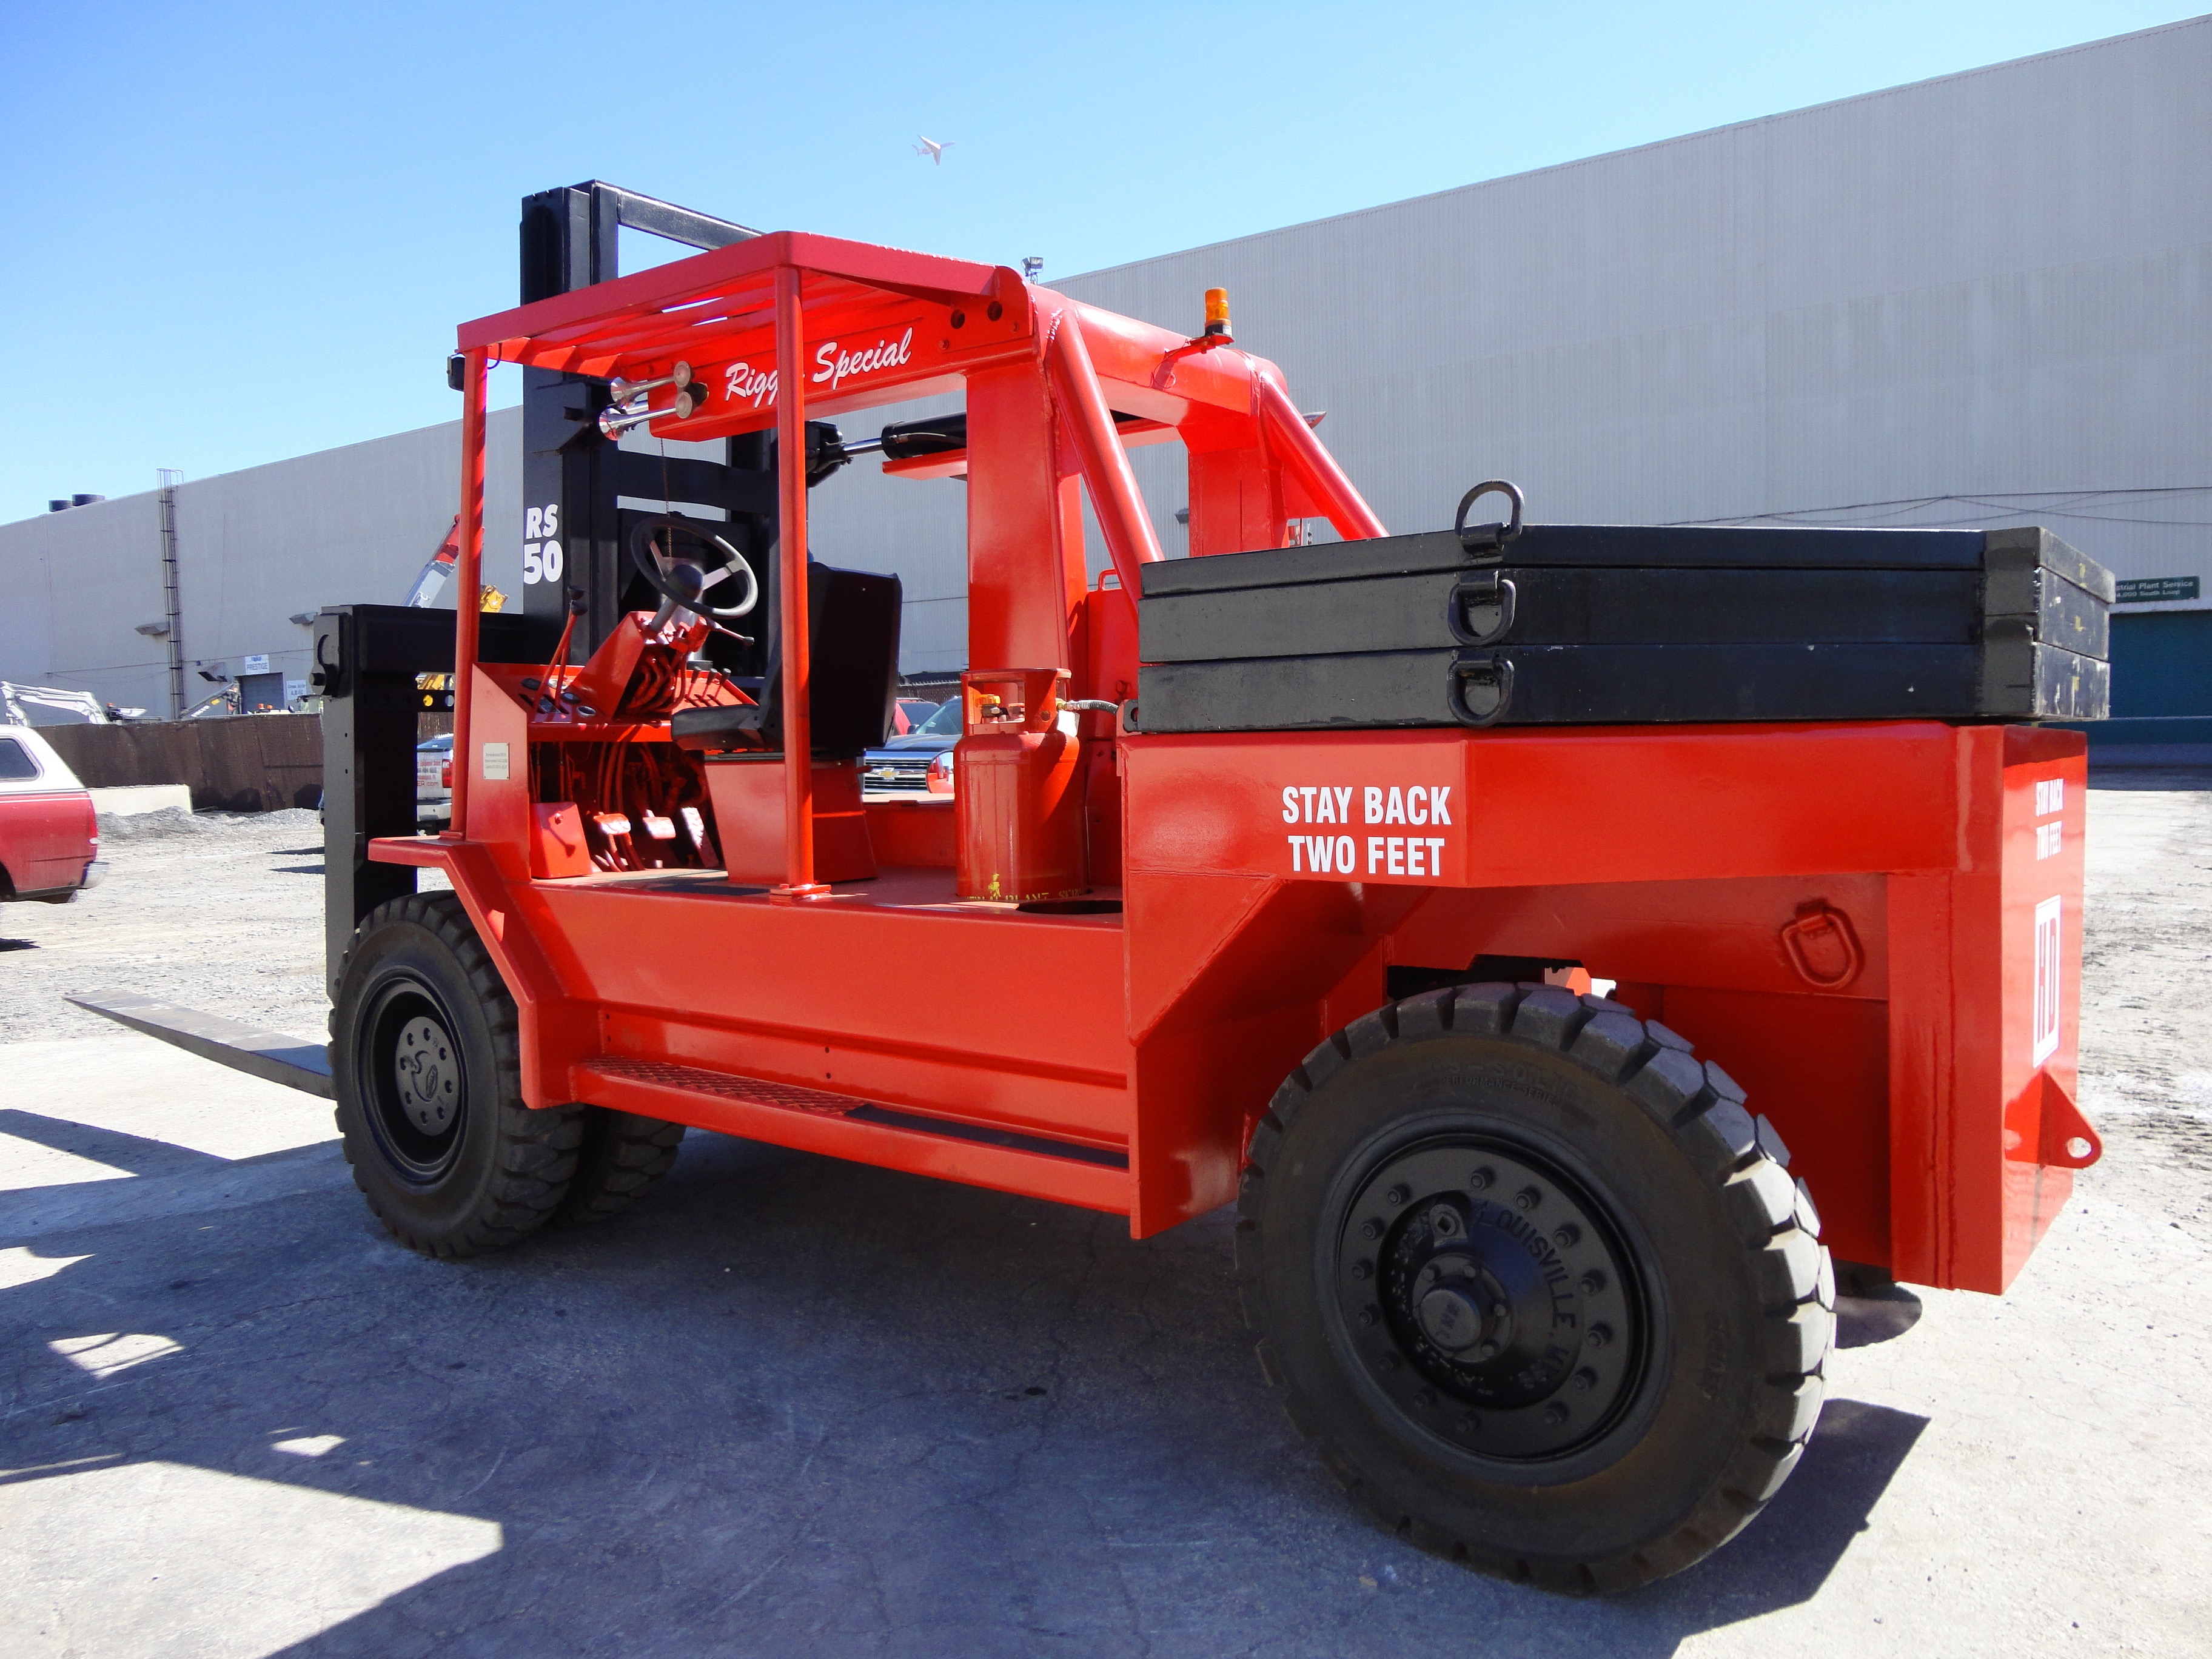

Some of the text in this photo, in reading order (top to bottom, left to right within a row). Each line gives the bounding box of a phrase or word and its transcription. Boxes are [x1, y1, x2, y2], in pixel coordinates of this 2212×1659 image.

[725, 327, 913, 408] Rigg Special
[526, 504, 558, 539] RS
[523, 540, 563, 585] 50
[2139, 581, 2159, 590] Plant
[2163, 580, 2194, 588] Service
[1282, 786, 1452, 825] STAY BACK
[1287, 835, 1446, 876] TWO FEET
